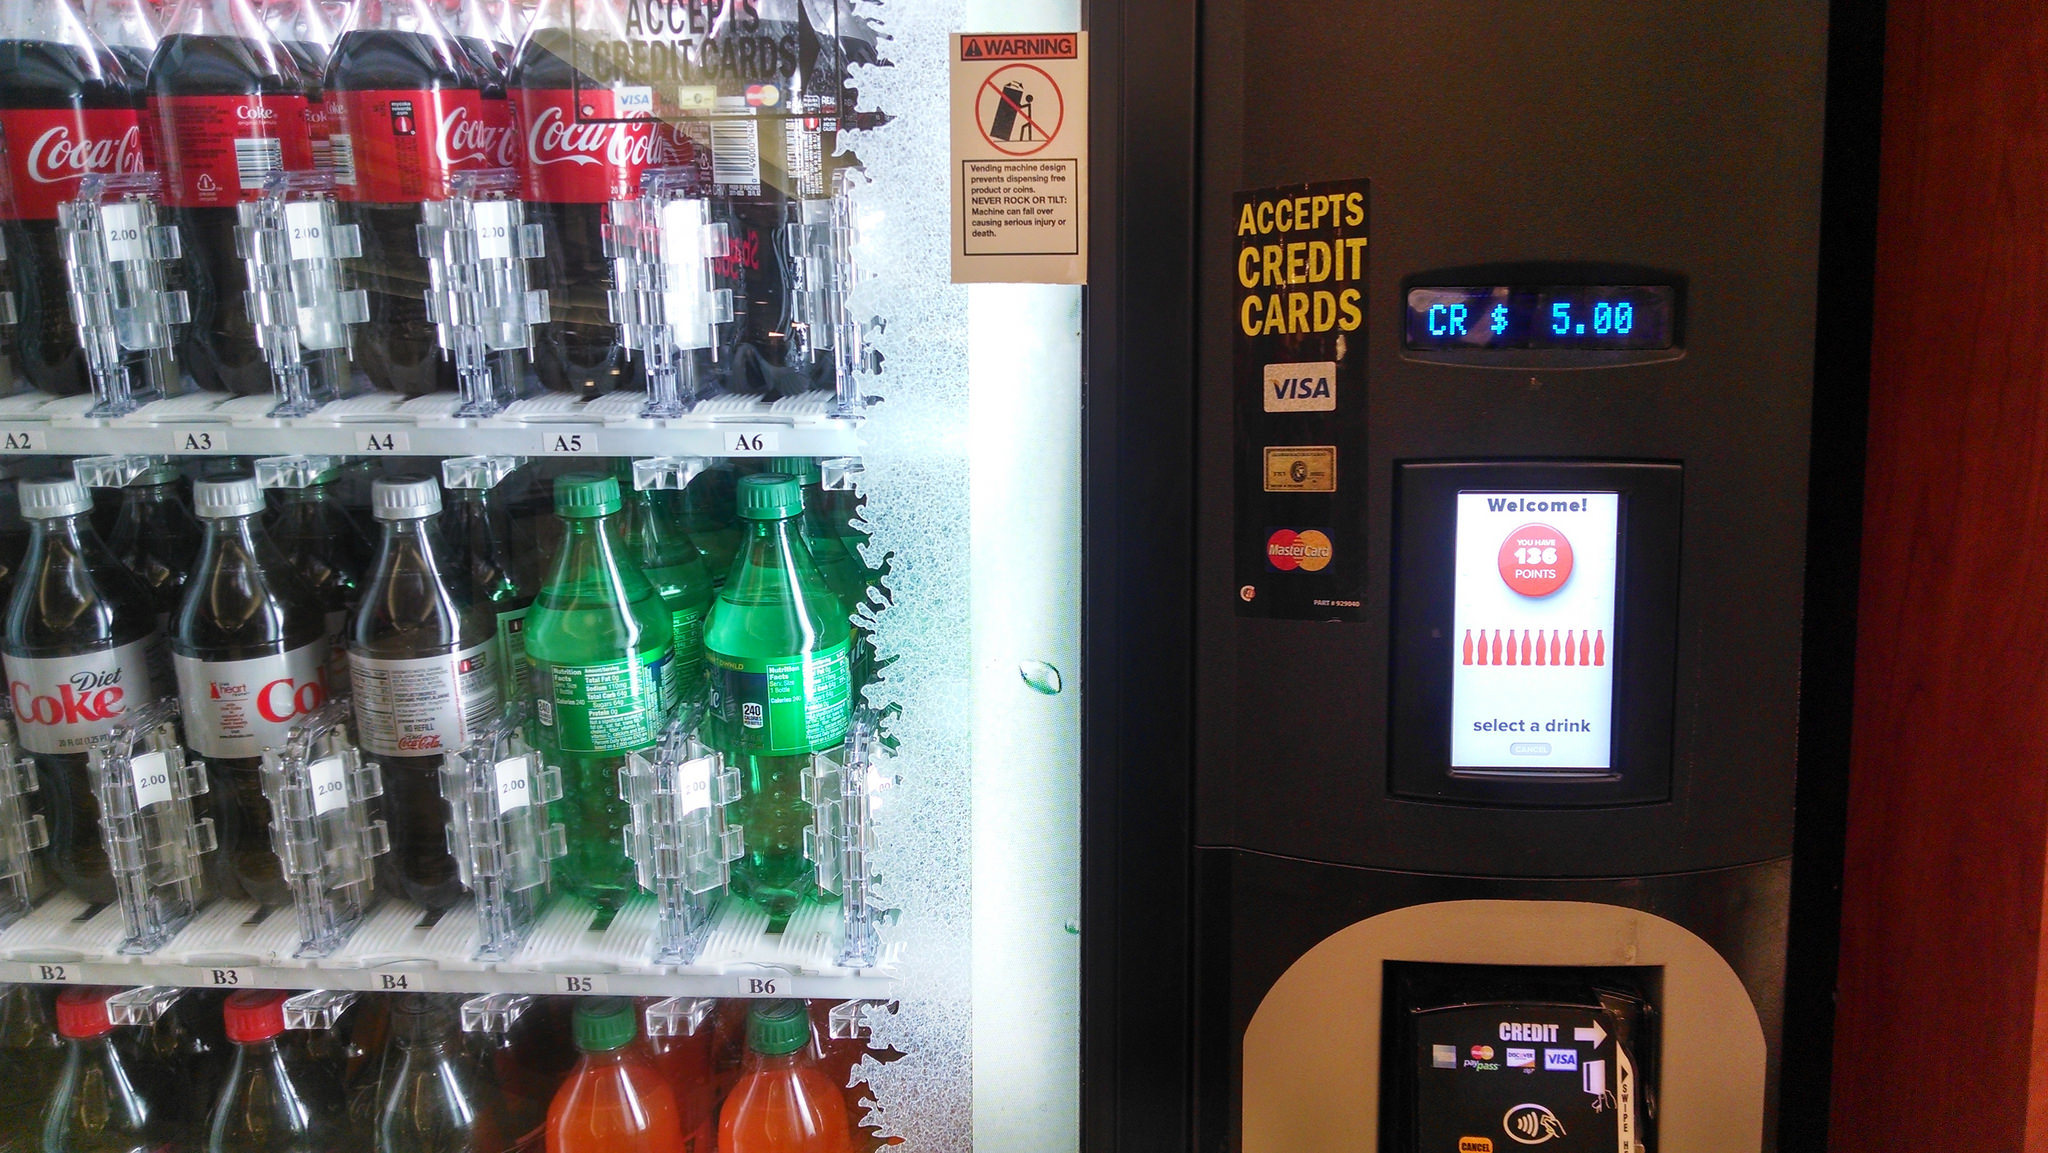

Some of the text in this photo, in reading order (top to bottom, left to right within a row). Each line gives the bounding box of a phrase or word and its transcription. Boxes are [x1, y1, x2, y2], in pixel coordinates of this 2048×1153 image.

[984, 39, 1072, 55] WARNING
[593, 34, 796, 82] CREDIT CARDS
[621, 94, 650, 105] VISA
[237, 105, 273, 120] Coke
[971, 163, 1066, 173] Vending machine design
[971, 174, 1066, 184] prevents dispensing free
[971, 186, 1001, 195] product
[1013, 186, 1036, 194] coins.
[971, 196, 1068, 205] NEVER ROCK OR TILT:
[1023, 207, 1035, 215] fall
[1237, 192, 1365, 236] ACCEPTS
[972, 219, 1002, 228] causing
[1004, 218, 1033, 226] serious
[1035, 218, 1056, 227] injury
[111, 229, 137, 241] 2.00
[295, 227, 320, 239] 2.00
[972, 229, 997, 238] death.
[1238, 237, 1368, 289] CREDIT
[1241, 288, 1362, 337] CARDS
[1429, 302, 1633, 336] CR $ 5.00
[1272, 377, 1331, 400] VISA
[5, 433, 32, 450] A2
[184, 433, 212, 450] A3
[367, 434, 395, 451] A4
[554, 434, 582, 452] A5
[735, 433, 764, 451] A6
[1487, 498, 1588, 513] Welcome!
[1268, 544, 1330, 558] MasterCard
[1514, 547, 1558, 565] 136
[1515, 569, 1556, 579] POINTS
[70, 667, 124, 692] Diet
[554, 668, 582, 676] Nutrition
[220, 685, 247, 694] heart
[10, 680, 127, 726] Coke
[744, 704, 761, 716] 240
[1473, 718, 1591, 733] select a drink
[398, 735, 441, 751] Coca-Cola
[1515, 745, 1548, 753] CANCEL
[140, 774, 167, 789] 2.00
[318, 781, 343, 796] 2.00
[502, 779, 526, 793] 2.00
[40, 965, 67, 981] B2
[212, 969, 239, 985] B3
[381, 973, 408, 990] B4
[566, 976, 593, 993] B5
[749, 978, 776, 995] B6
[1499, 1022, 1560, 1042] CREDIT
[1548, 1054, 1576, 1065] VISA
[1621, 1084, 1629, 1132] SWIPE
[1461, 1142, 1490, 1152] CANCEL
